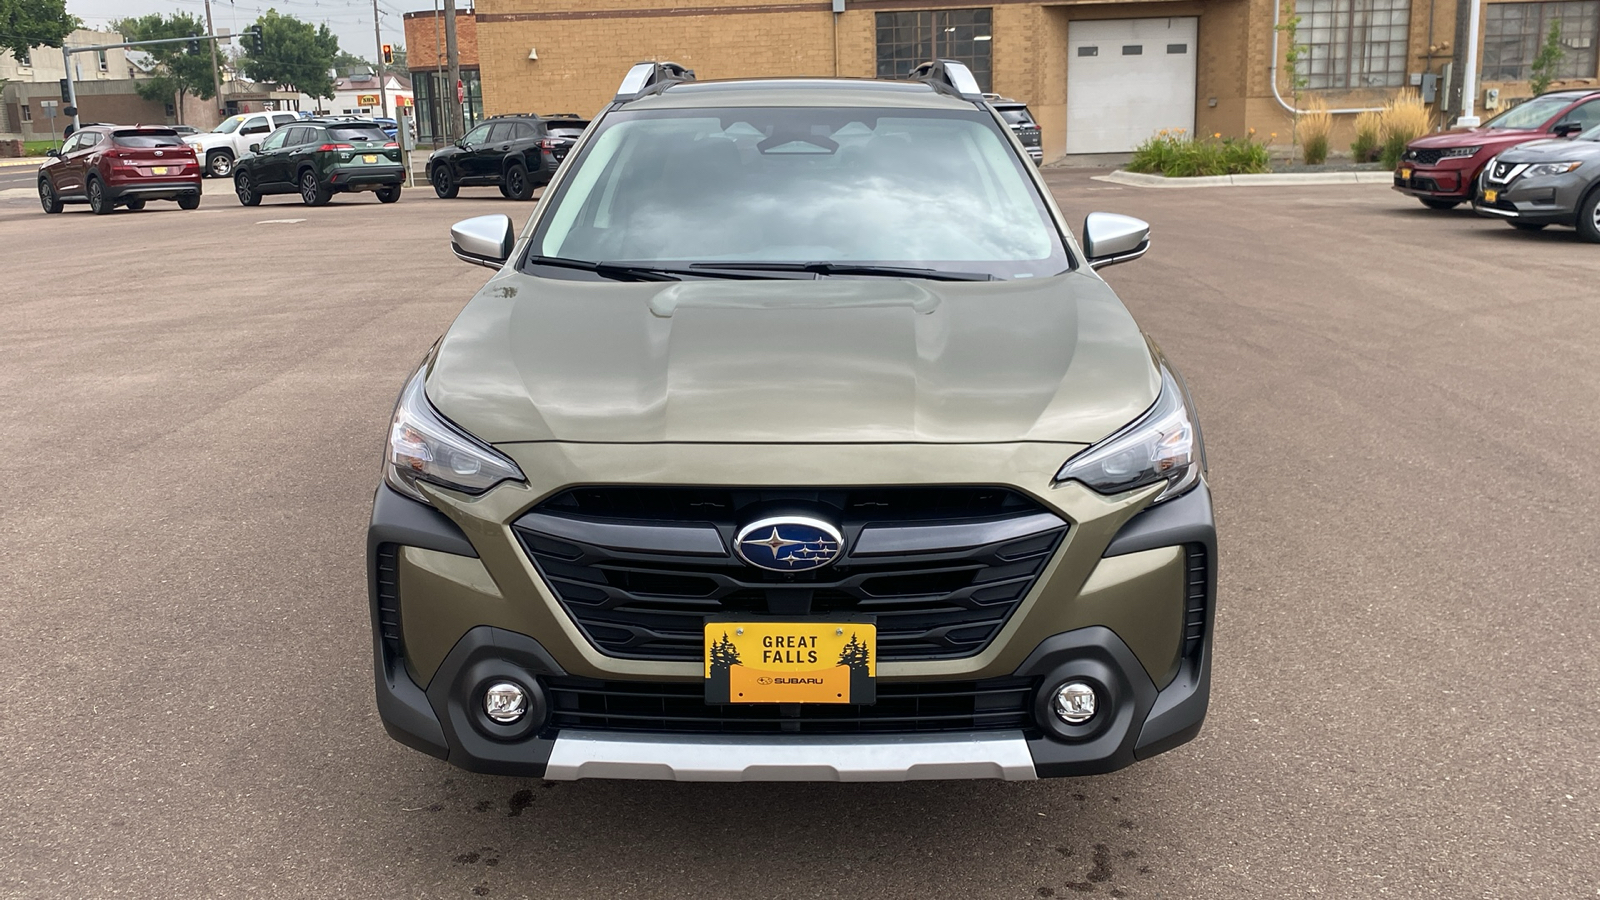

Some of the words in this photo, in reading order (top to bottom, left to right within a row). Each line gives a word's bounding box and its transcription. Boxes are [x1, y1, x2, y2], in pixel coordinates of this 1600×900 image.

[763, 636, 818, 648] GREAT
[763, 650, 818, 663] FALLS
[774, 677, 824, 685] SUBARU
